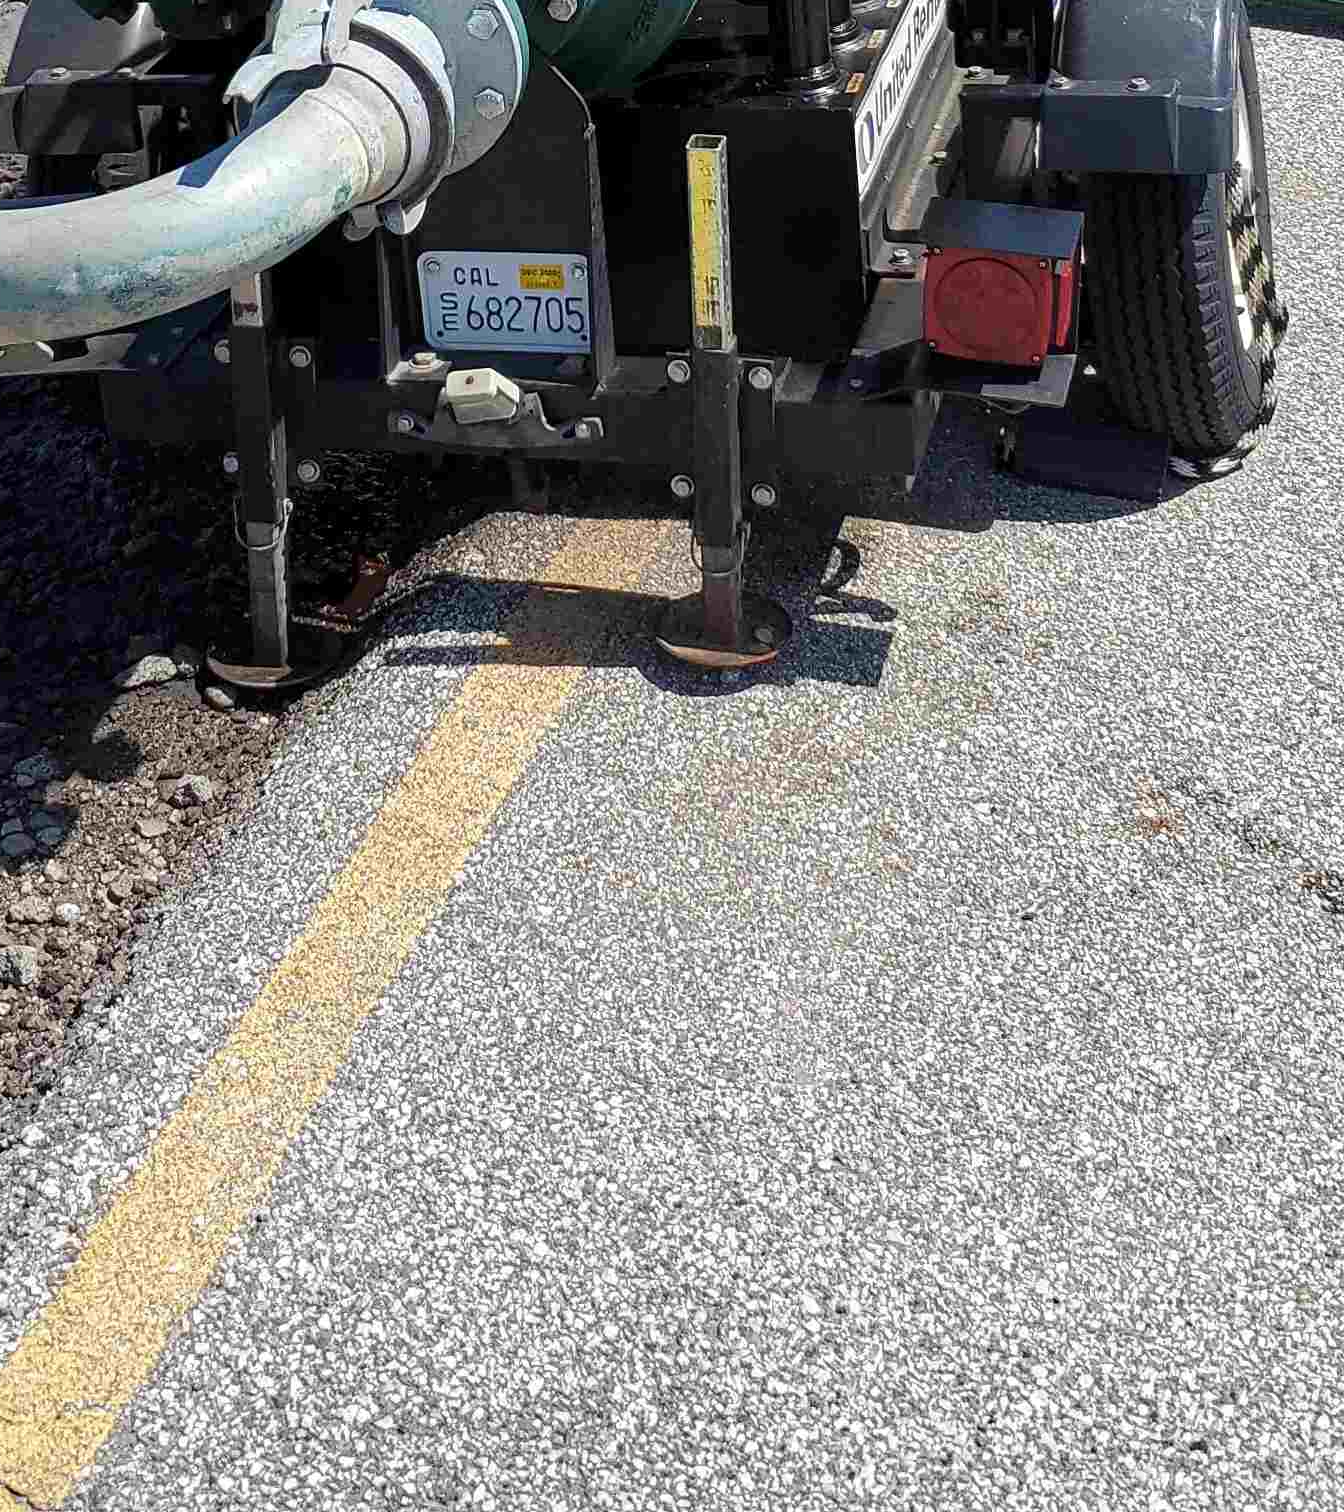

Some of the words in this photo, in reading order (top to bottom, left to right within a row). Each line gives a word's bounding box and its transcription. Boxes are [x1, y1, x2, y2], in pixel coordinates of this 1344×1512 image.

[874, 24, 913, 137] United
[453, 266, 500, 287] CAL
[466, 295, 585, 334] 682705
